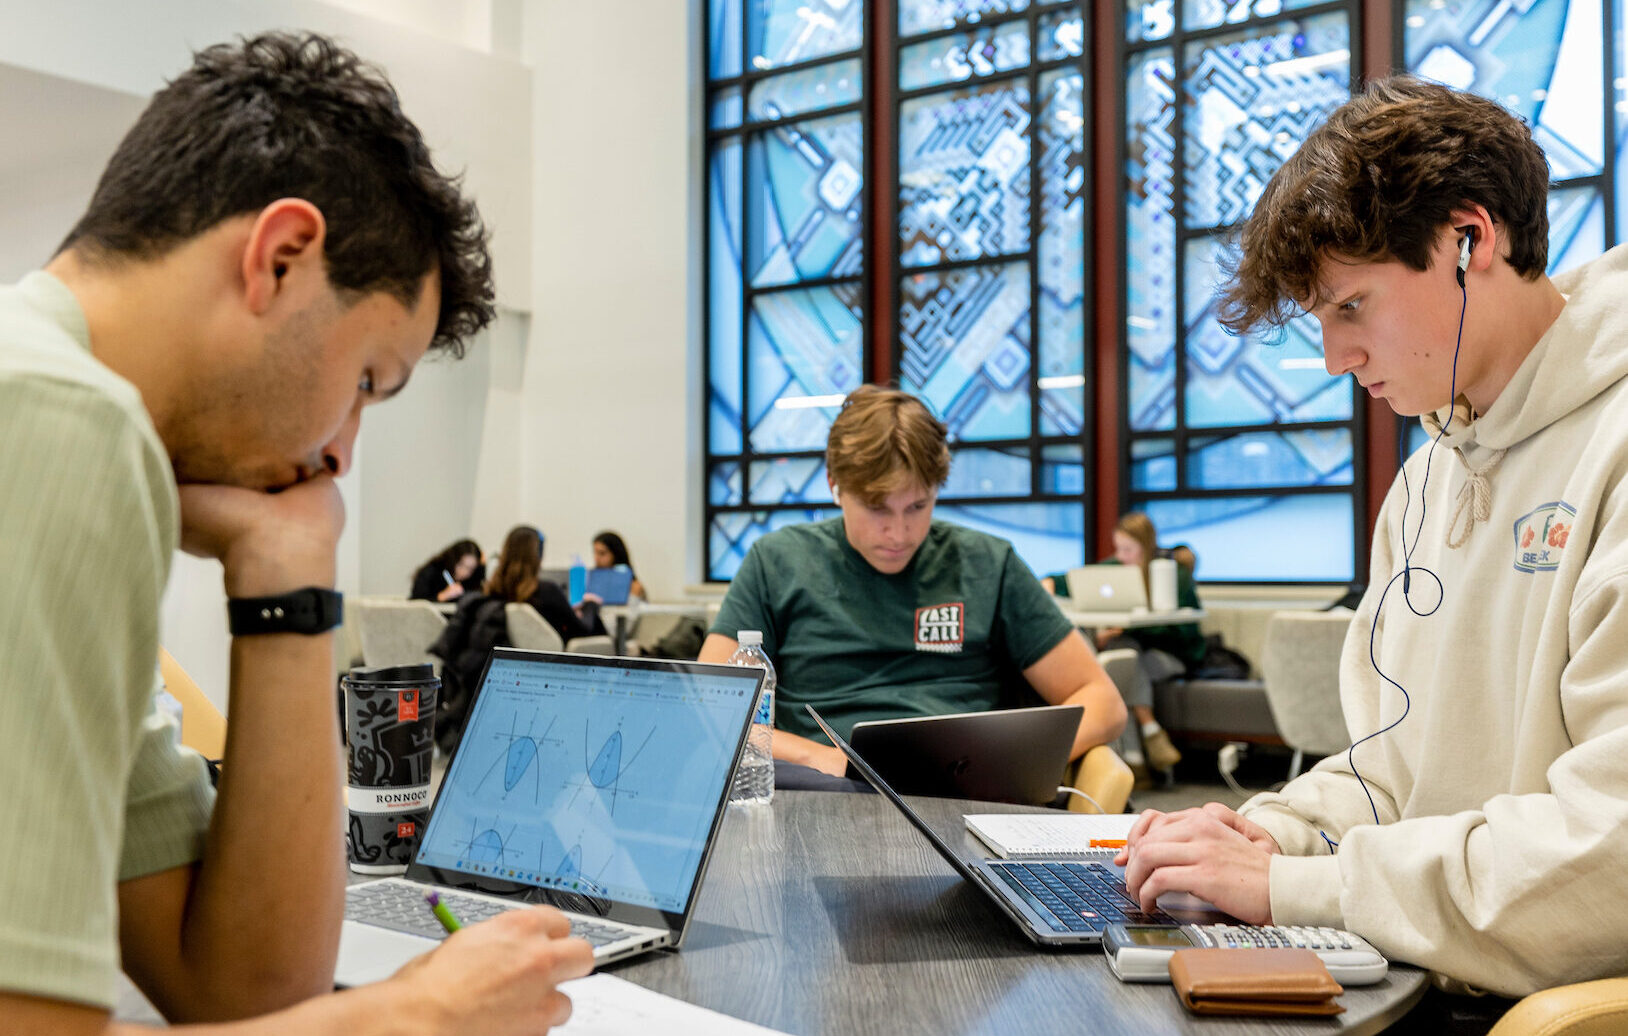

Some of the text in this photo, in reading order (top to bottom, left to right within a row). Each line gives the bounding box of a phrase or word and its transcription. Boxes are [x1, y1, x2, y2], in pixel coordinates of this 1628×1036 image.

[919, 606, 959, 627] LAST
[918, 625, 959, 642] CALL
[376, 790, 427, 803] RONNOCO
[401, 826, 412, 834] 24
